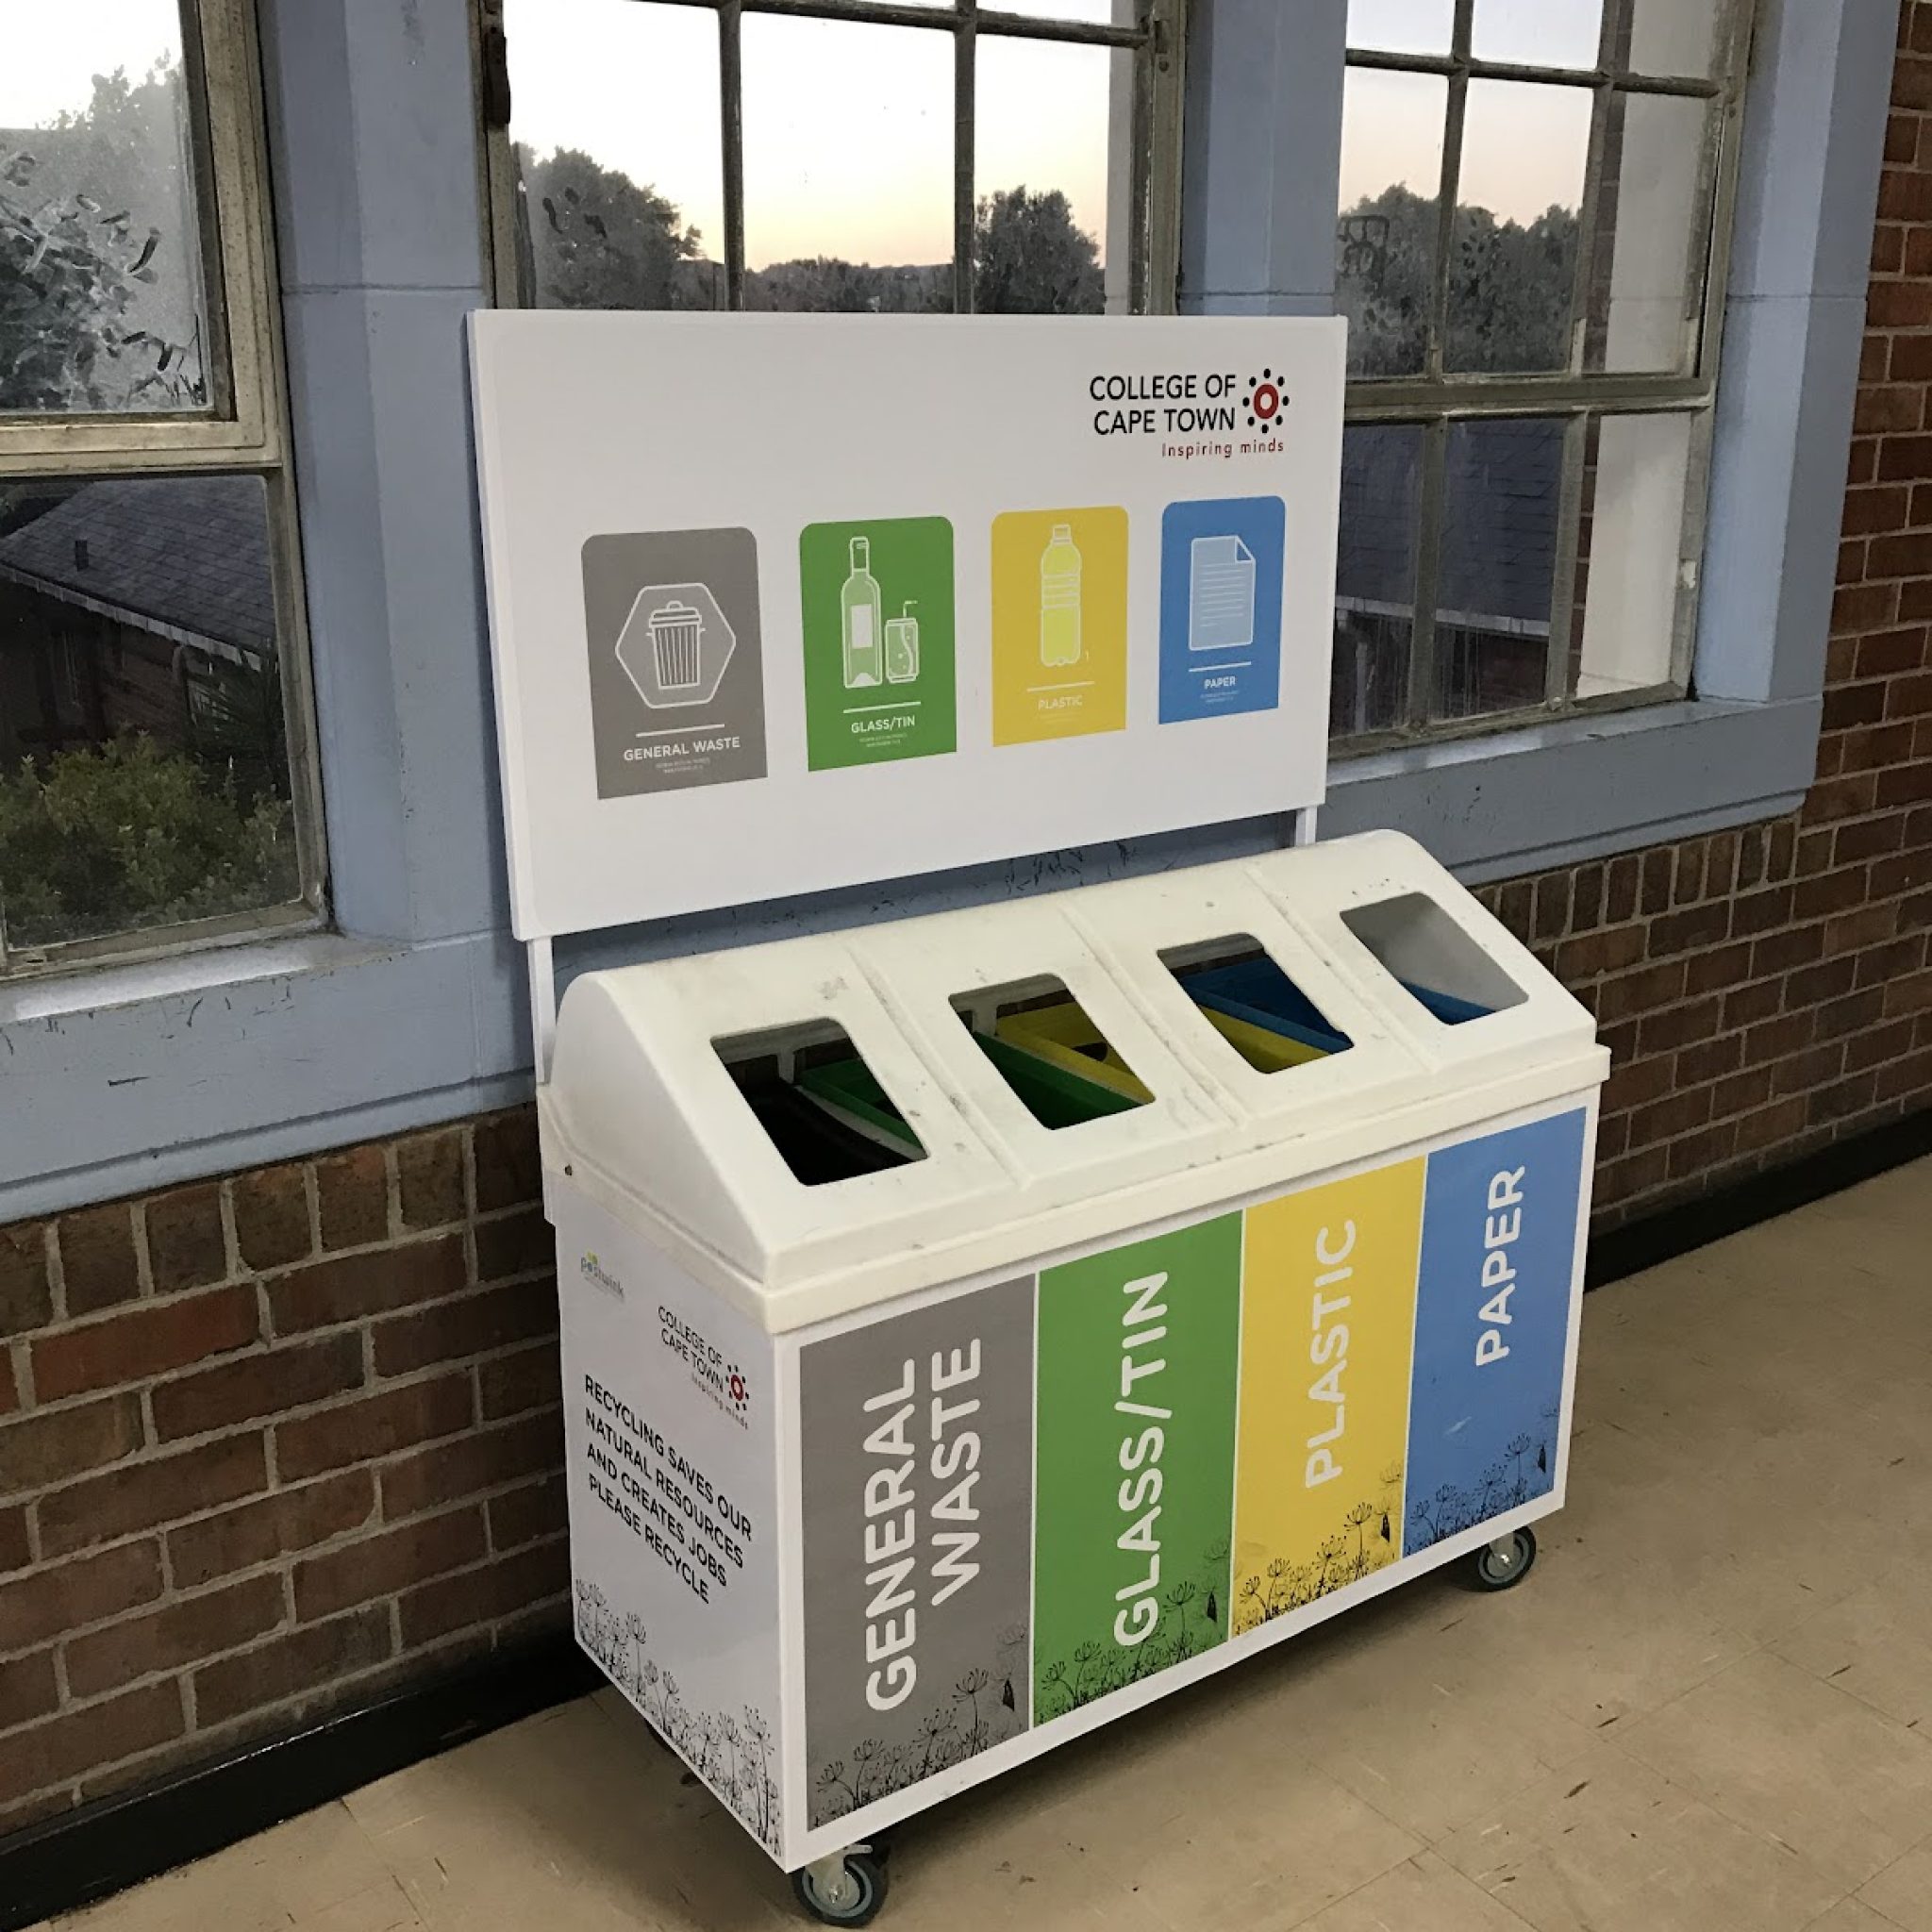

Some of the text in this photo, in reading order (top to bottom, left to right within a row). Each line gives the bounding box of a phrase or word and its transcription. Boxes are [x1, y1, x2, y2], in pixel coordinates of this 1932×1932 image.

[1090, 374, 1236, 401] COLLEGE OF
[1094, 407, 1236, 435] CAPE TOWN
[1161, 438, 1284, 458] Inspiring minds
[851, 715, 915, 734] GLASS/TIN
[1038, 694, 1082, 710] PLASTIC
[1203, 675, 1236, 690] PAPER
[624, 736, 741, 761] GENERAL WASTE
[1475, 1165, 1525, 1366] PAPER
[658, 1306, 723, 1367] COLLEGE OF
[660, 1327, 724, 1393] CAPE TOWN
[1305, 1219, 1357, 1489] PLASTIC
[585, 1374, 752, 1541] RECYCLING SAVES OUR
[585, 1407, 743, 1569] NATURAL RESOURCES
[930, 1338, 982, 1607] WASTE
[1113, 1271, 1173, 1647] GLASS/TIN
[587, 1442, 727, 1587] AND CREATES JOBS
[589, 1473, 709, 1605] PLEASE RECYCLE
[862, 1357, 918, 1711] GENERAL
